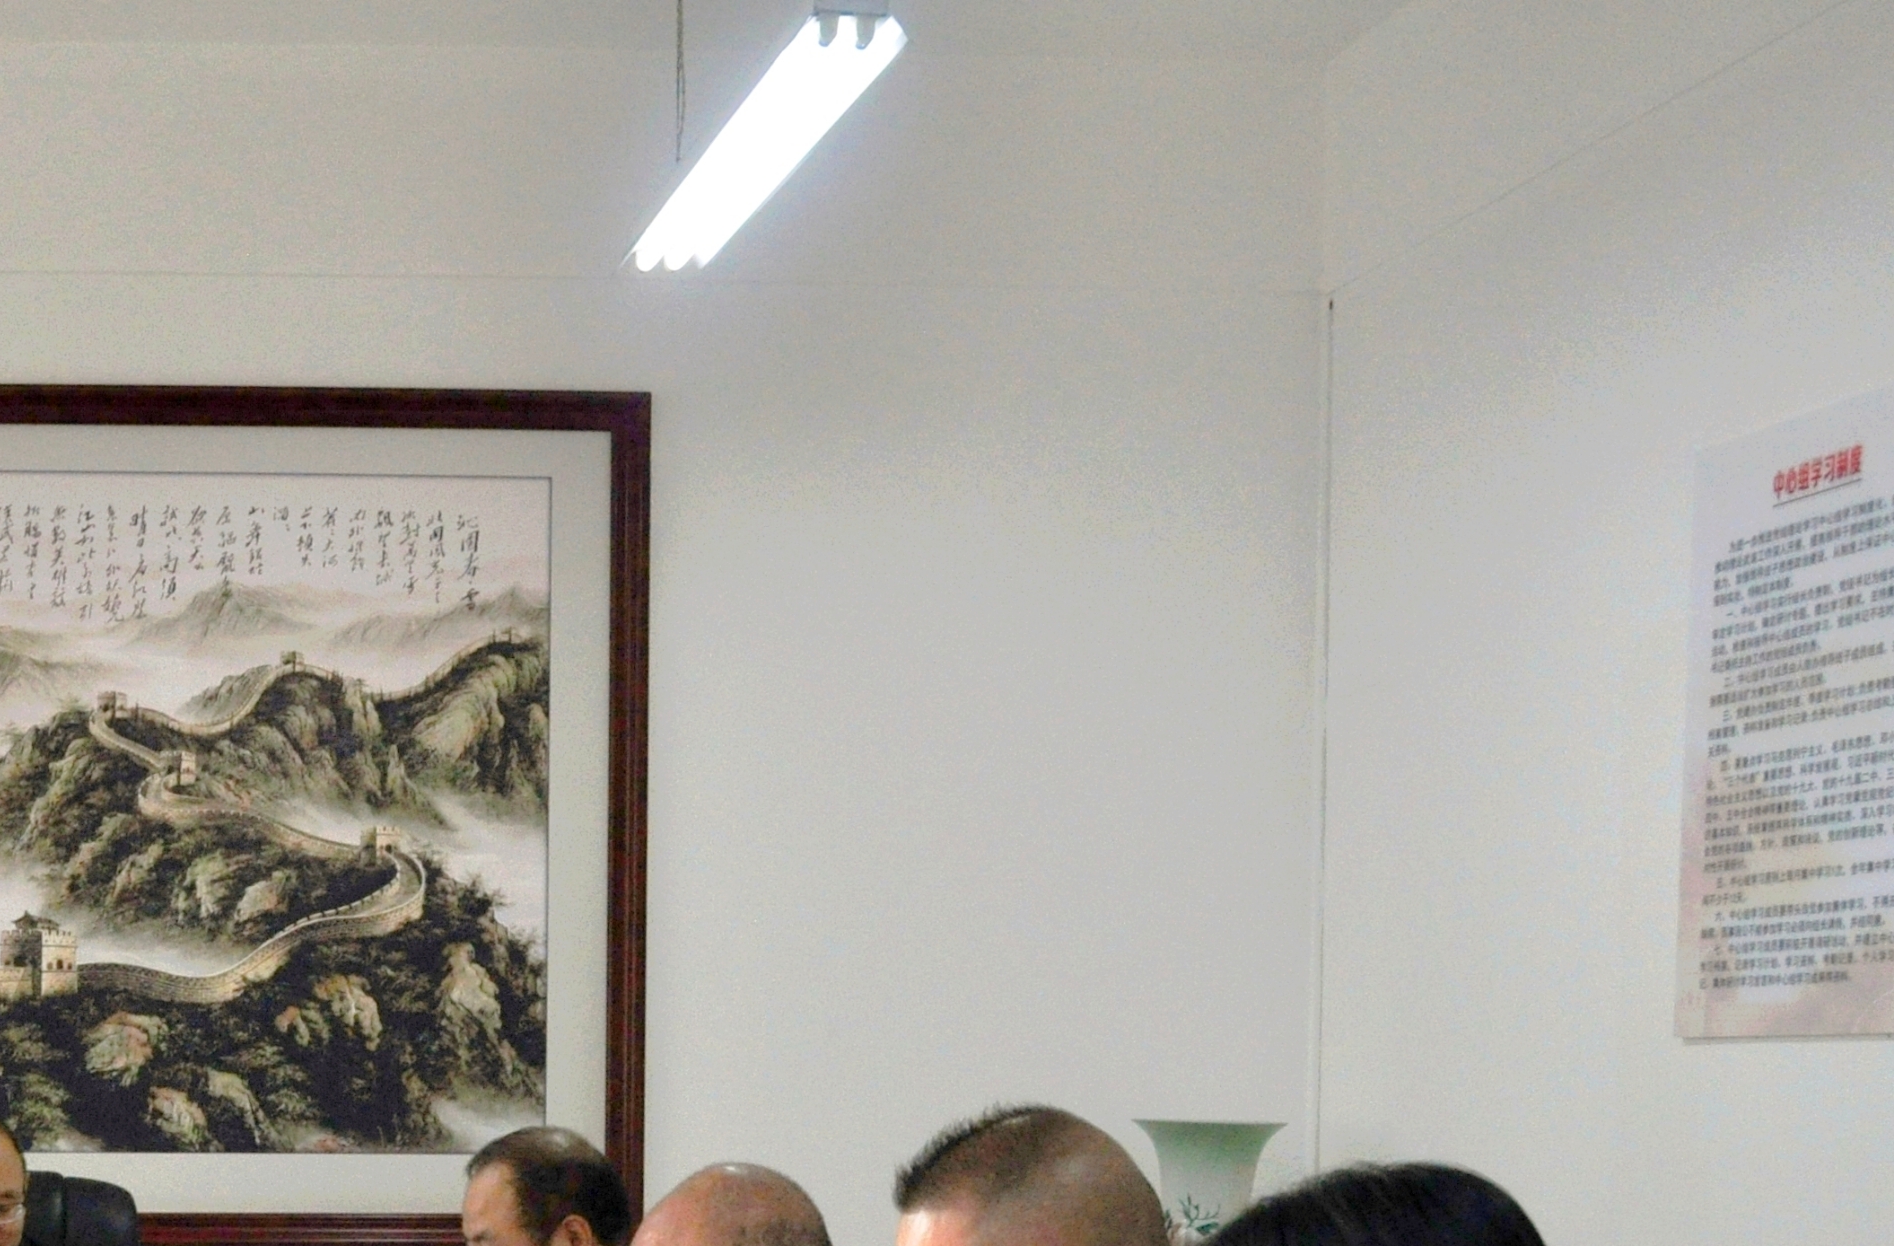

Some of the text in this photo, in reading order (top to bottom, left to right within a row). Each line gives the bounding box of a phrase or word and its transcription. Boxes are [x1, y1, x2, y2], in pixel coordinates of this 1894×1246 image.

[1772, 444, 1863, 500] 中心组学习制度
